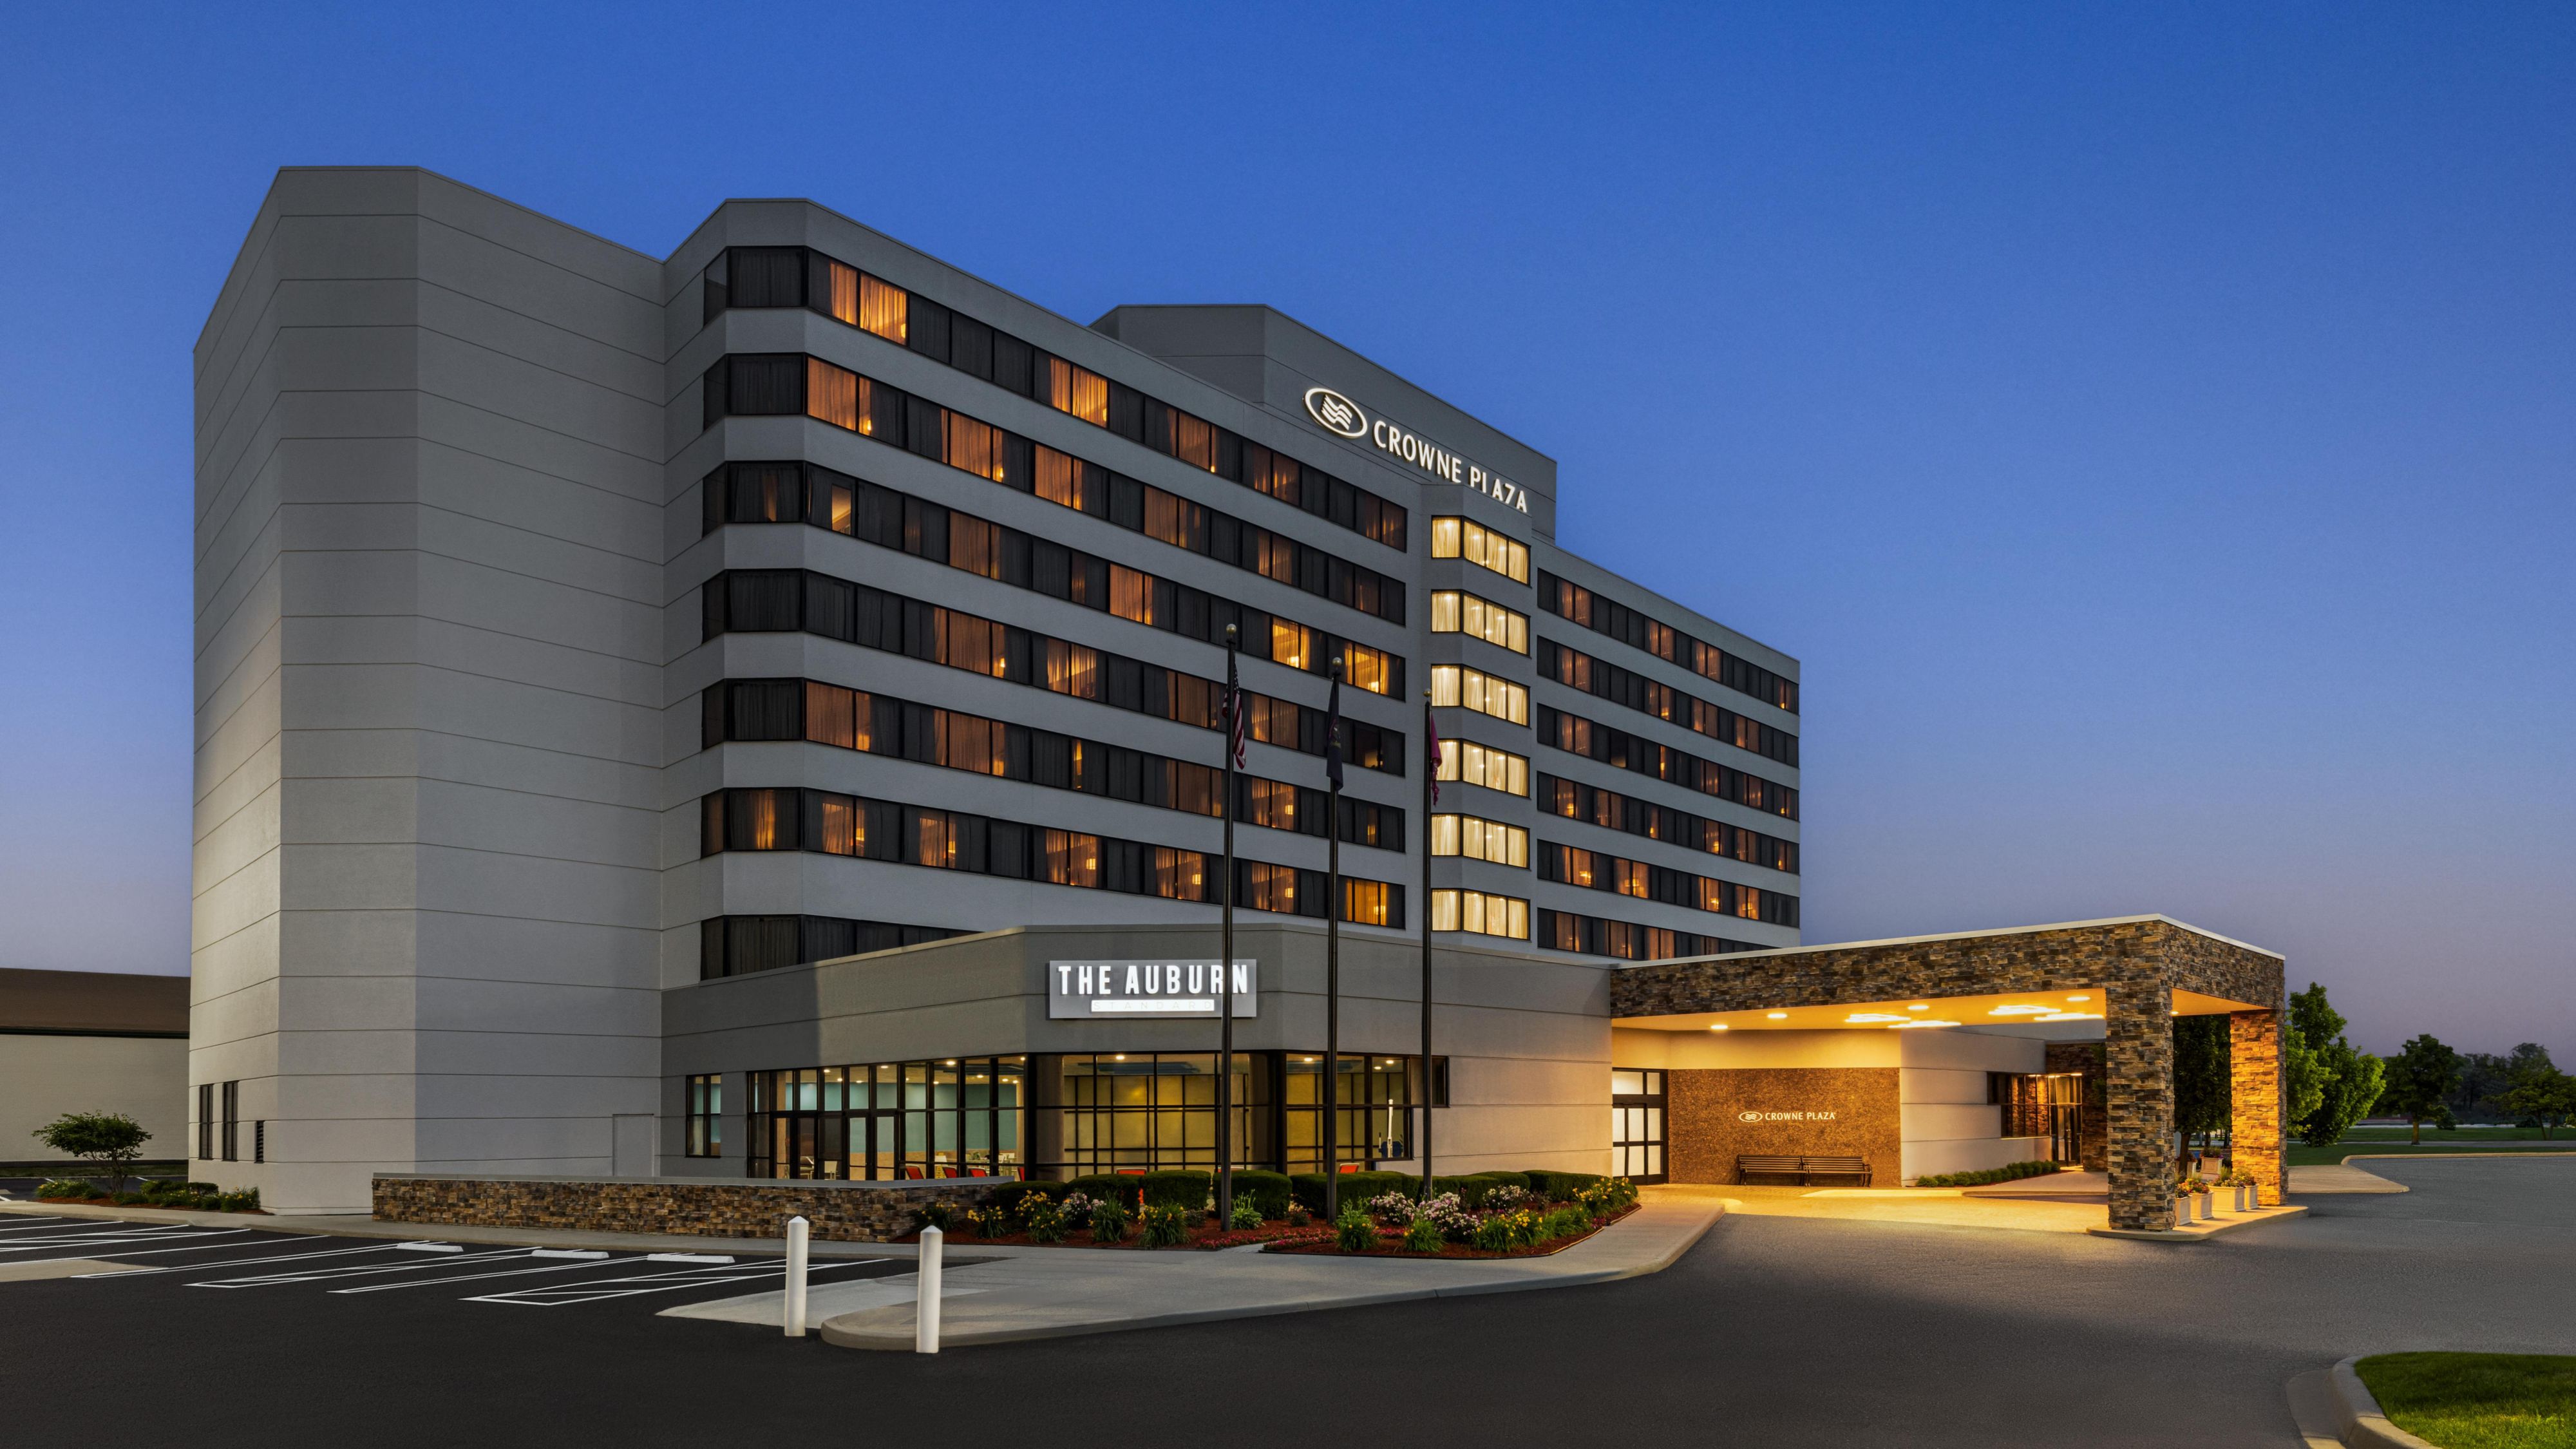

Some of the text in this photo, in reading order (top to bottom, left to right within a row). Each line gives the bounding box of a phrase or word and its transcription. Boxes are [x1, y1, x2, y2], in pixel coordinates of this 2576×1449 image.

[1373, 421, 1462, 483] CROWNE
[1058, 965, 1247, 995] THE AUBURN
[1094, 1001, 1211, 1010] STANDARD
[1765, 1112, 1803, 1121] CROWNE
